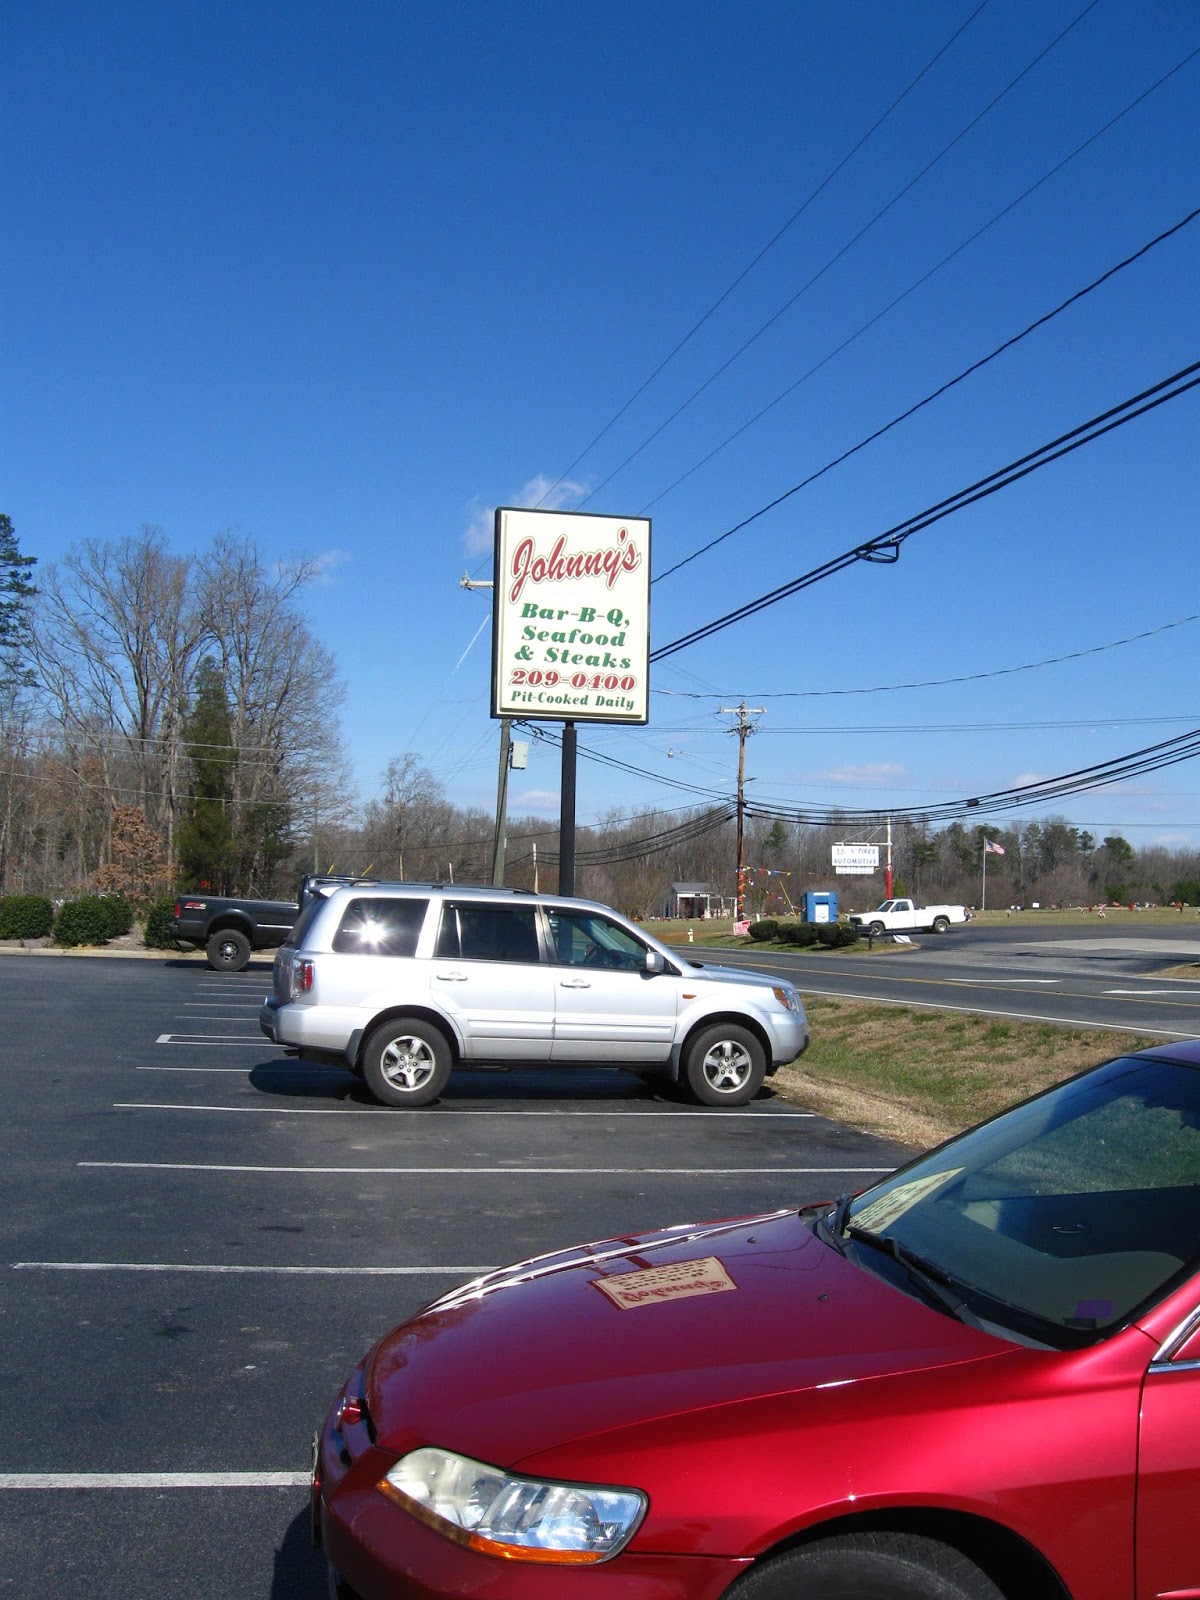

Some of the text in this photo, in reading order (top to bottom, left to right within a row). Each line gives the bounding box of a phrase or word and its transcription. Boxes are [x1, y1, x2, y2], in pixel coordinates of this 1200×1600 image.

[510, 528, 641, 604] Johnny's
[520, 603, 630, 627] Bar-B-Q,
[521, 626, 626, 646] Seafood
[514, 645, 631, 669] & Steaks
[510, 668, 637, 691] 209-0400
[511, 691, 634, 711] Pit-Cooked Daily
